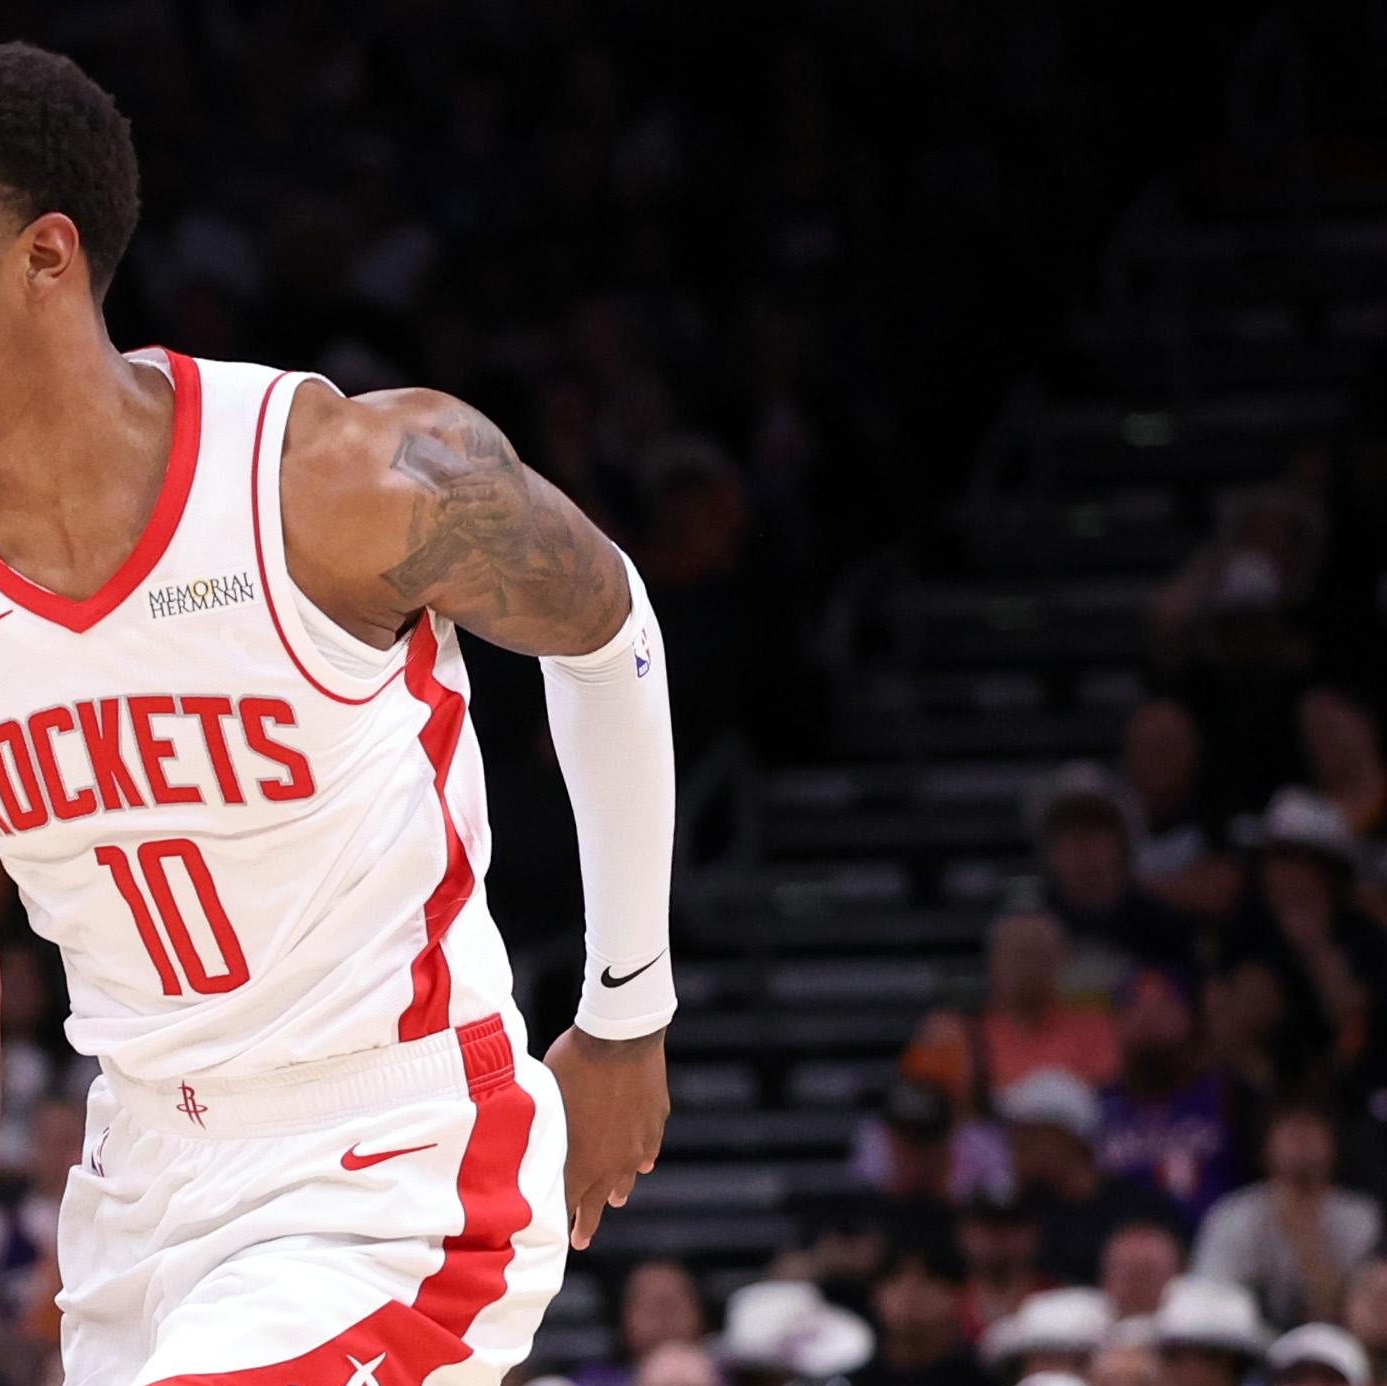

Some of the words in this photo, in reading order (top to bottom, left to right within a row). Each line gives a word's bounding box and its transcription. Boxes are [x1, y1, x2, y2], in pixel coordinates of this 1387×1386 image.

[148, 572, 253, 605] MEMORIAL
[150, 584, 255, 619] HERMANN
[95, 838, 251, 997] 10
